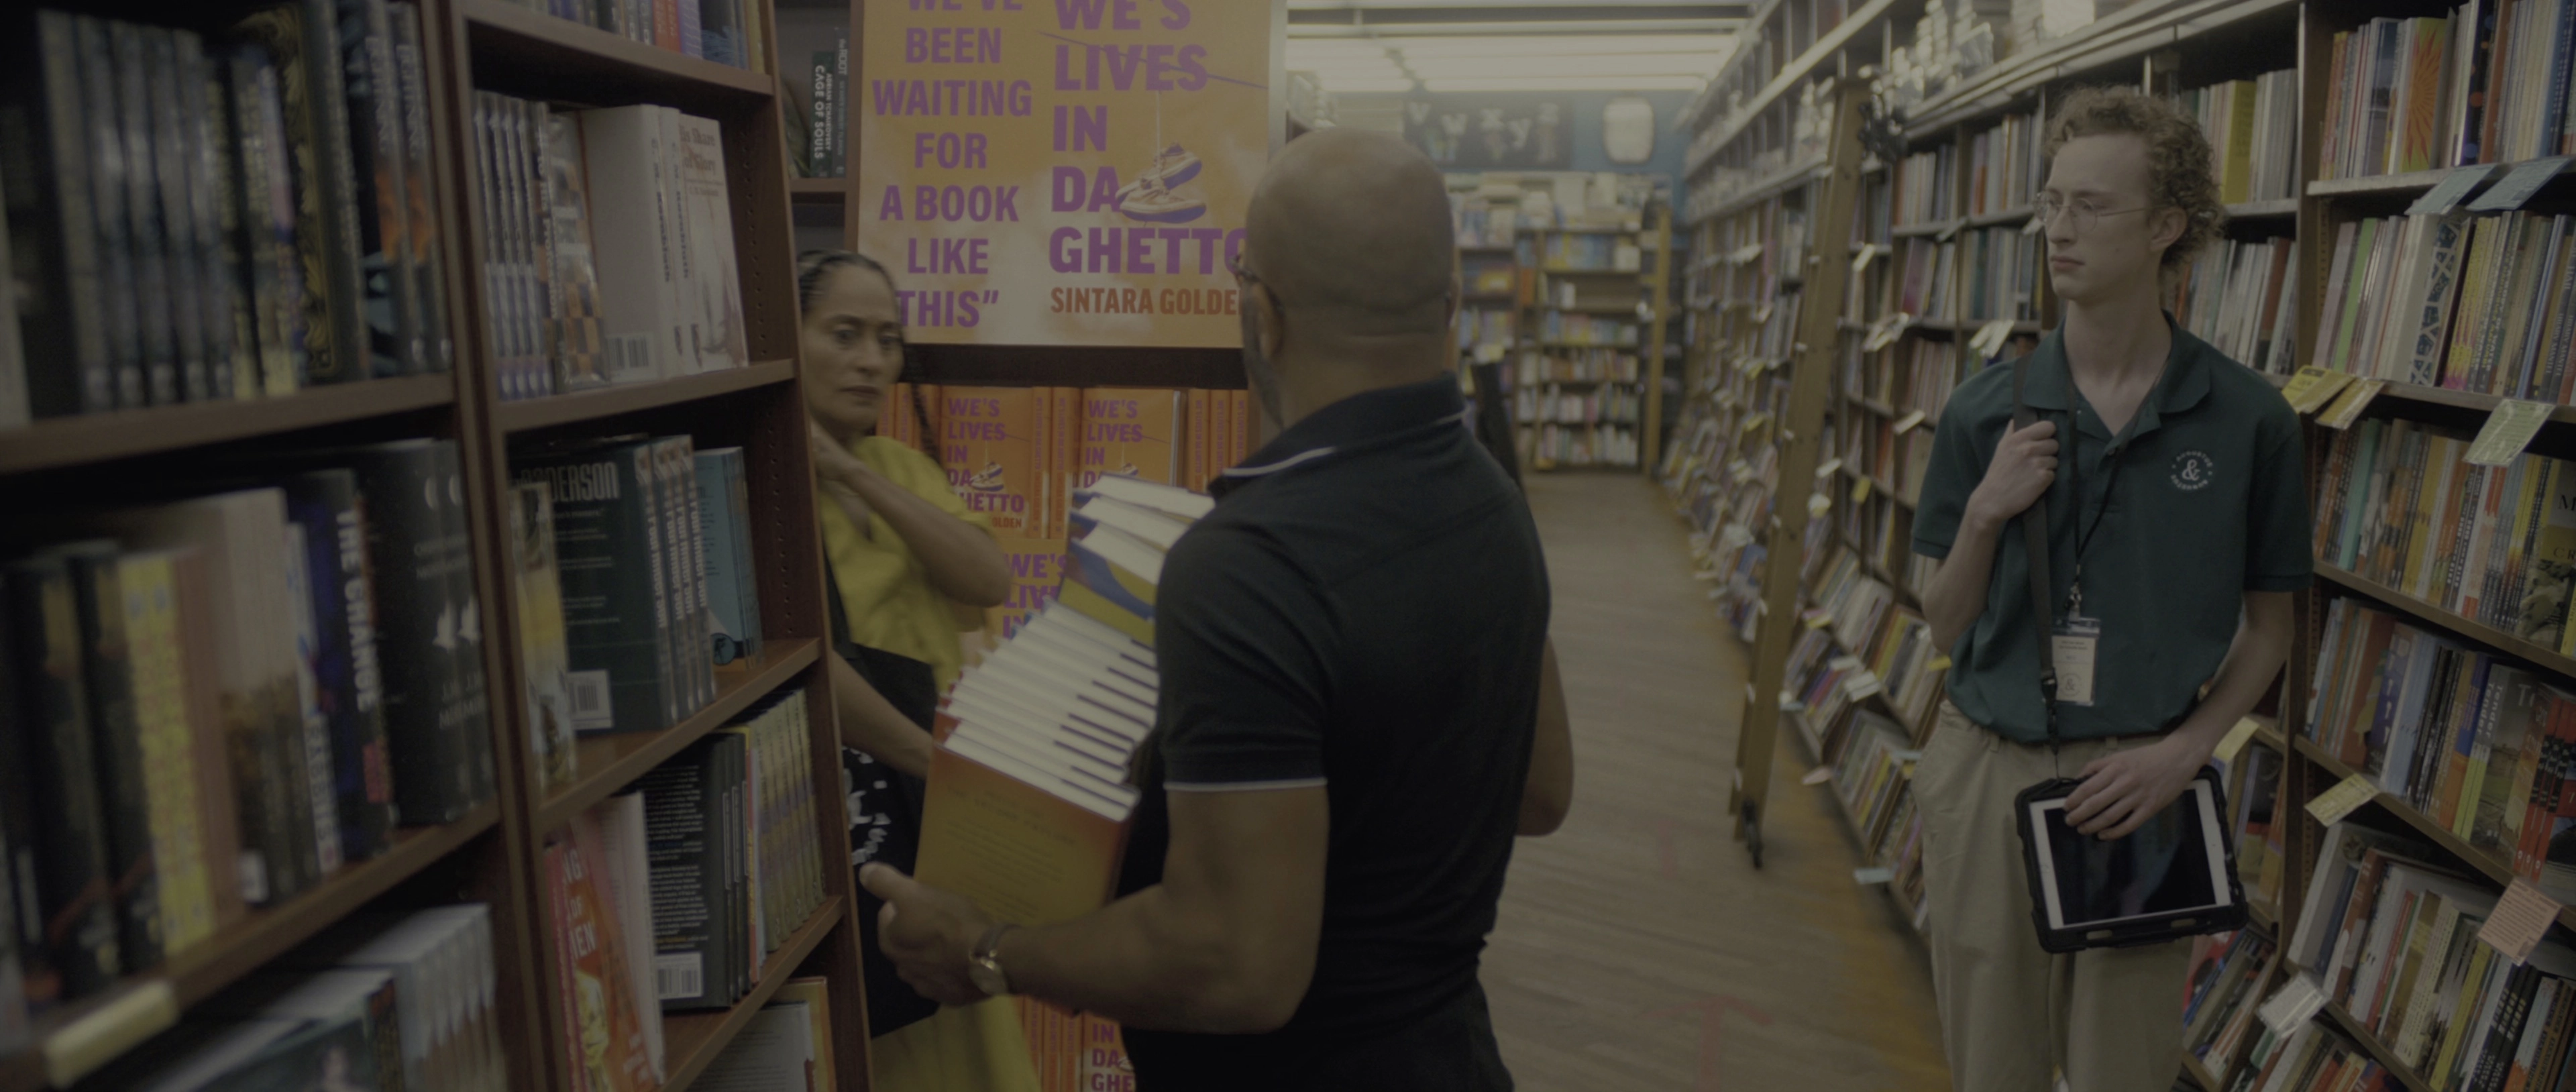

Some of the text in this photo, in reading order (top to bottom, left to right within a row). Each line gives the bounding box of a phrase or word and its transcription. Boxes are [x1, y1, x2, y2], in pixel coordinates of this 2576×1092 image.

[1055, 0, 1191, 30] WE'S
[905, 28, 1002, 64] BEEN
[1055, 44, 1208, 91] LIVES
[813, 65, 825, 159] CAGE OF SOULS
[873, 80, 1032, 116] WAITING
[824, 103, 833, 150] TCHAIKOVSKY
[1053, 105, 1108, 152] IN
[914, 132, 987, 169] FOR
[879, 185, 1020, 222] A BOOK
[1052, 166, 1120, 213] DA
[908, 238, 989, 274] LIKE
[1051, 288, 1242, 315] SINTARA GOLDE
[2546, 342, 2557, 374] MANTEL
[2557, 344, 2567, 377] MANTEL
[948, 398, 1000, 417] WE'S
[1088, 400, 1138, 419] WE'S
[948, 423, 1007, 441] LIVES
[1087, 424, 1142, 442] LIVES
[947, 445, 968, 463] IN
[1085, 447, 1105, 465] IN
[2182, 459, 2200, 481] &
[991, 517, 1022, 529] OLDEN
[1003, 585, 1059, 608] LIV
[343, 578, 375, 712] CHANGE
[2477, 681, 2494, 736] Tender
[2485, 684, 2502, 739] Tender
[1092, 1022, 1114, 1044] IN
[1092, 1048, 1120, 1069] DA
[1091, 1073, 1134, 1092] GHE
